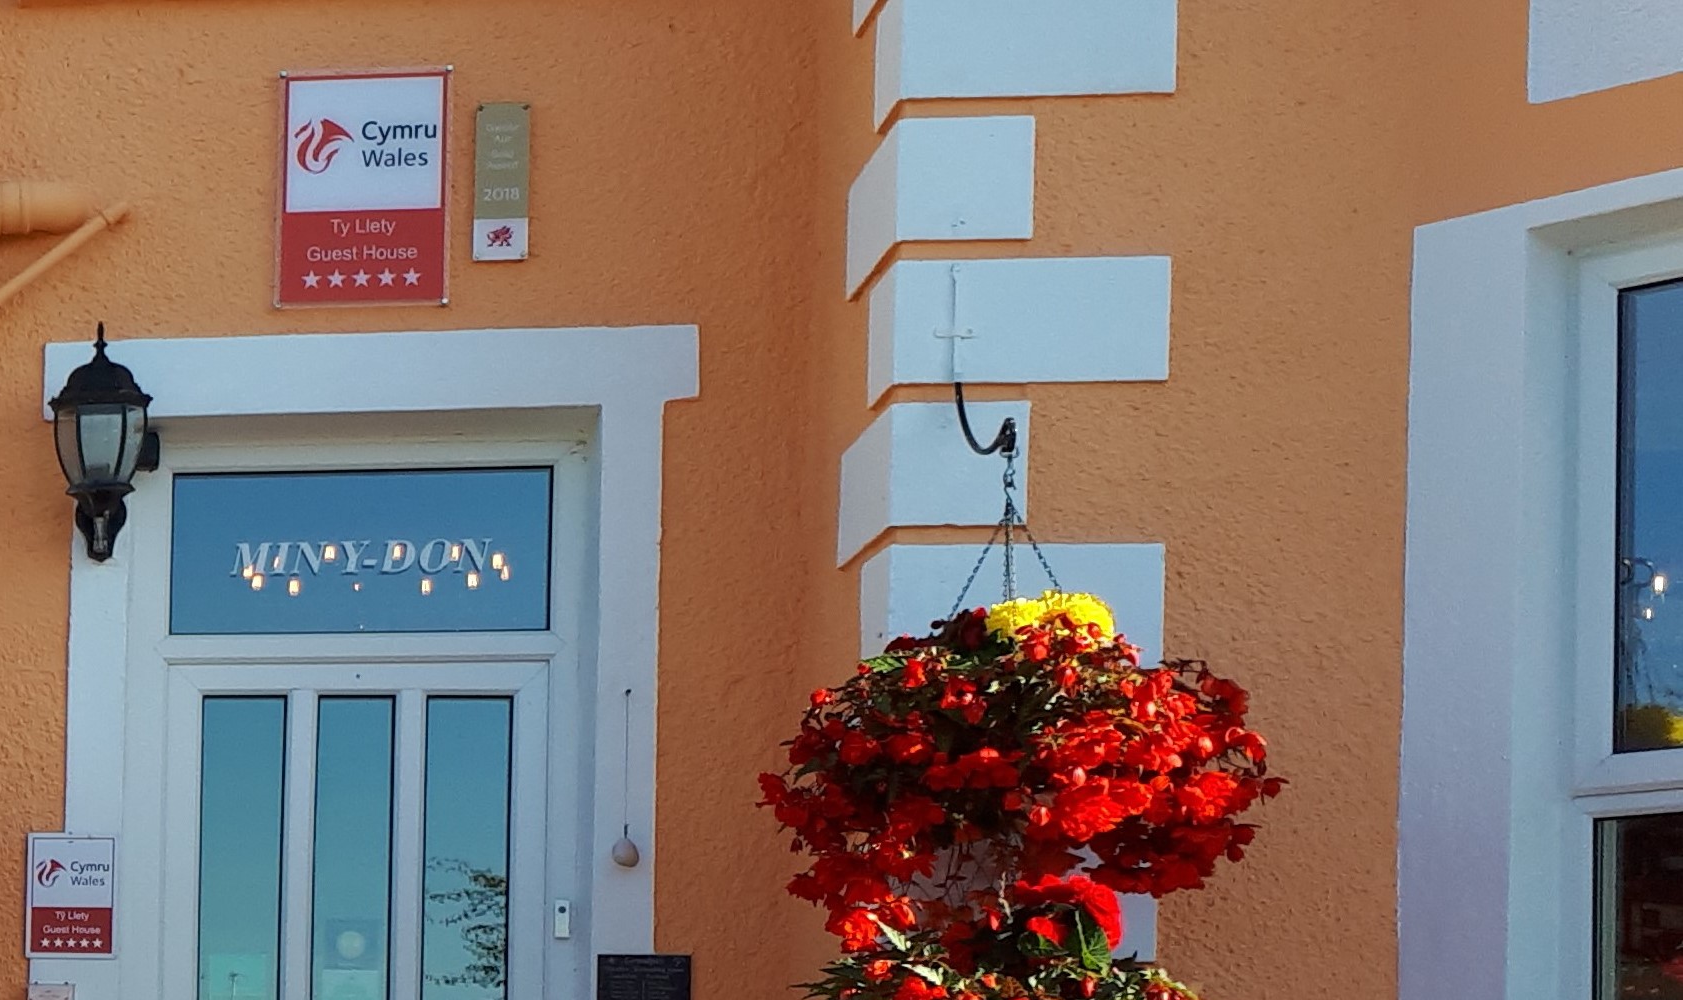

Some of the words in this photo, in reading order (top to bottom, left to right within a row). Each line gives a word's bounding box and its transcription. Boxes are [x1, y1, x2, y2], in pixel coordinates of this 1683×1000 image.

[361, 120, 438, 146] Cymru
[361, 148, 429, 168] Wales
[483, 187, 520, 201] 2018
[330, 218, 351, 237] Ty
[355, 218, 396, 236] Llety
[306, 246, 357, 262] Guest
[363, 244, 418, 260] House
[229, 541, 329, 577] MIN
[70, 860, 110, 875] Cymru
[70, 875, 106, 887] Wales
[42, 924, 70, 934] Guest
[72, 925, 101, 935] House
